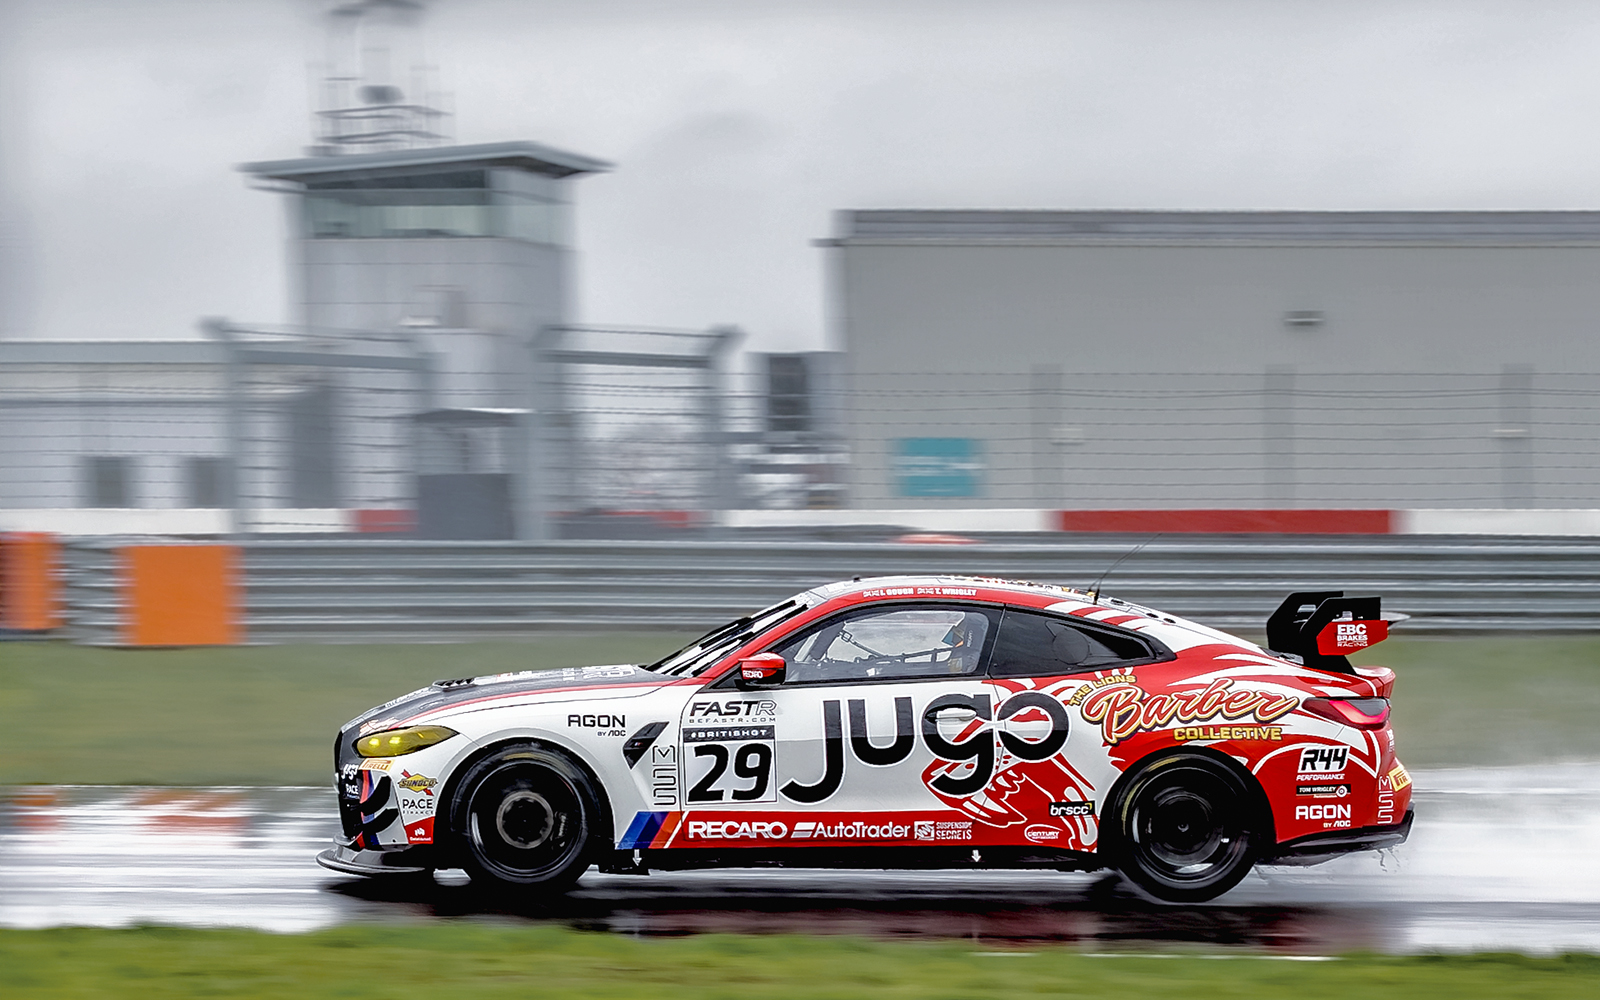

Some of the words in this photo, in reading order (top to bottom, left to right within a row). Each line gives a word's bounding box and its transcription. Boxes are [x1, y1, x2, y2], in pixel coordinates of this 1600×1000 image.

[942, 588, 977, 596] WRIGLEY
[1337, 624, 1367, 635] EBC
[1069, 684, 1093, 706] THE
[1093, 675, 1136, 688] LIONS
[689, 700, 776, 716] FASTR
[1081, 677, 1299, 743] Barber
[568, 714, 626, 728] AGON
[1173, 727, 1282, 740] COLLECTIVE
[778, 690, 1070, 804] jugo
[1301, 748, 1349, 771] R44
[687, 743, 772, 801] 29
[402, 799, 434, 809] PACE
[1050, 804, 1089, 816] brscc
[1295, 804, 1351, 820] AGON
[688, 821, 788, 839] RECARO
[813, 822, 911, 838] AutoTrader
[936, 821, 972, 829] SUSPENSION
[936, 829, 972, 840] SECRETS
